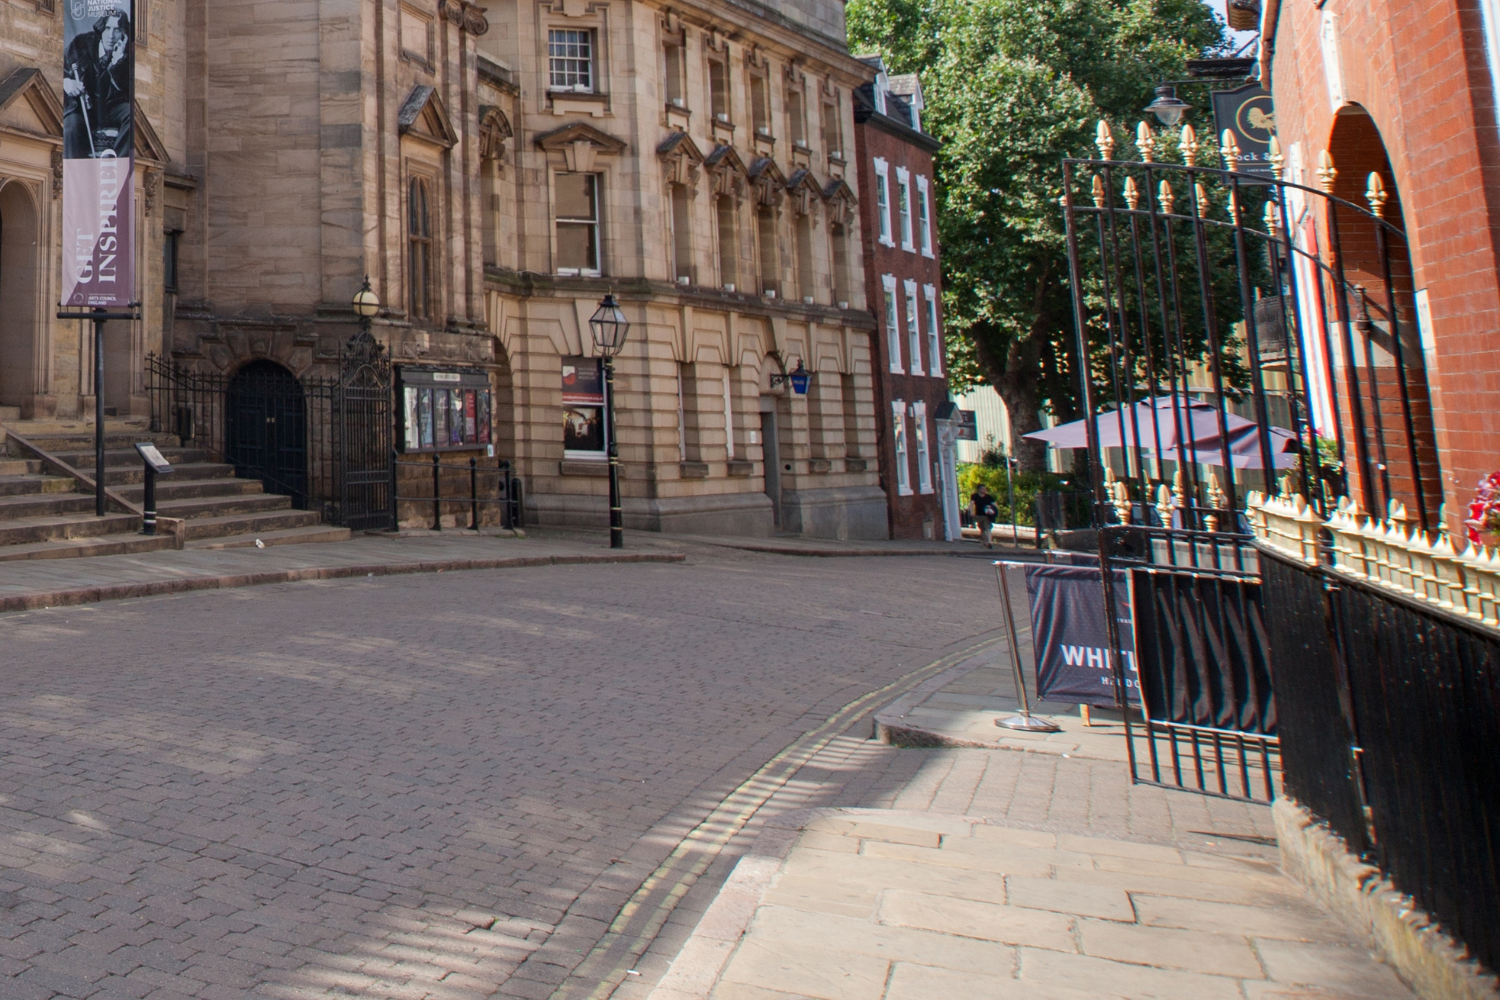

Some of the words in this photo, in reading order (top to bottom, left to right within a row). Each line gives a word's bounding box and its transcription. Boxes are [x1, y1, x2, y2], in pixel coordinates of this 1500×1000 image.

[87, 4, 115, 12] JUSTICE
[87, 10, 117, 18] MUSEUM
[98, 148, 118, 284] INSPIRED
[75, 228, 94, 285] GET
